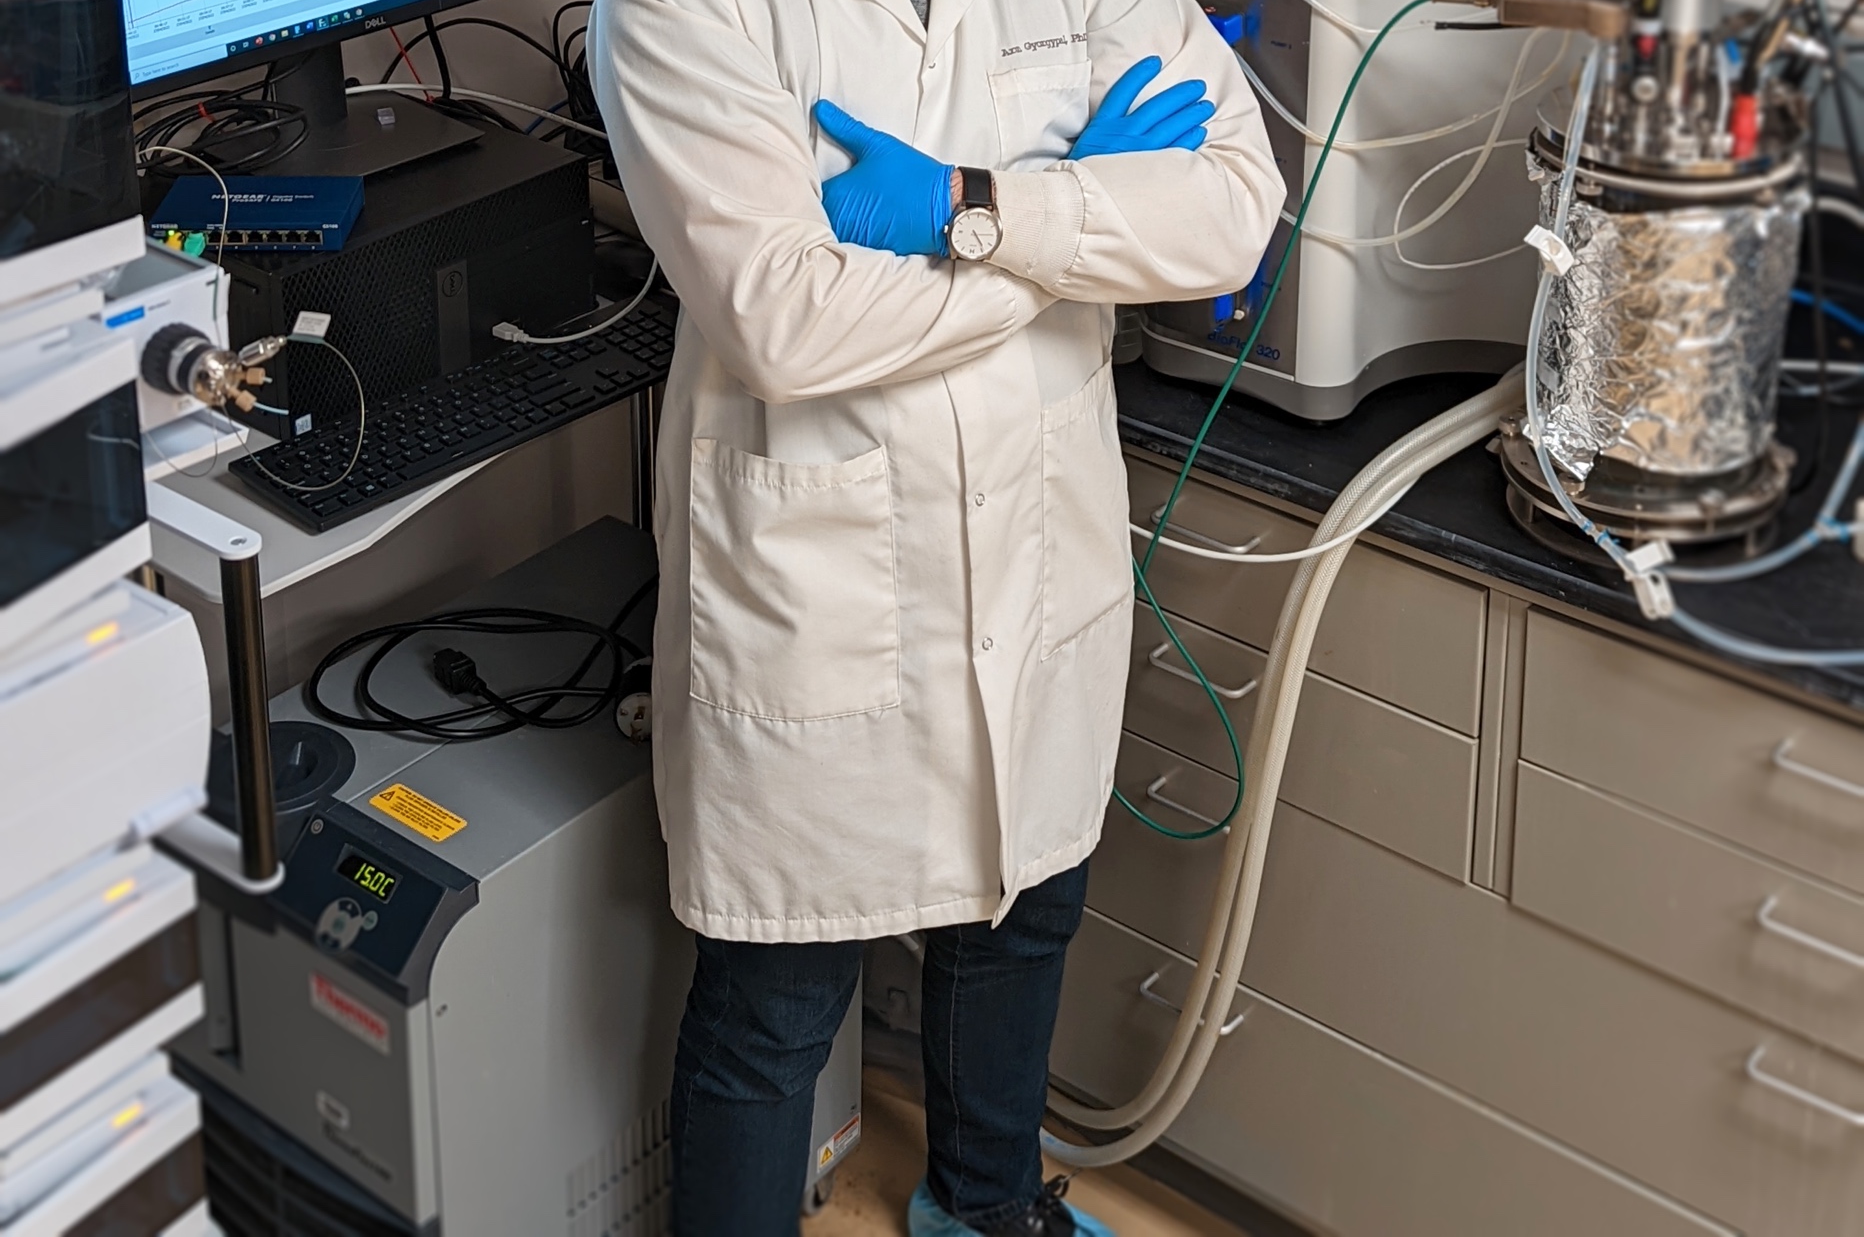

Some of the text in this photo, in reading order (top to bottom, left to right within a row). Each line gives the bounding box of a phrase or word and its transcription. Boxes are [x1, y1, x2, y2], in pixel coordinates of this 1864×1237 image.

[365, 16, 386, 29] DELL
[1001, 46, 1022, 57] Ara
[1256, 344, 1280, 360] 320
